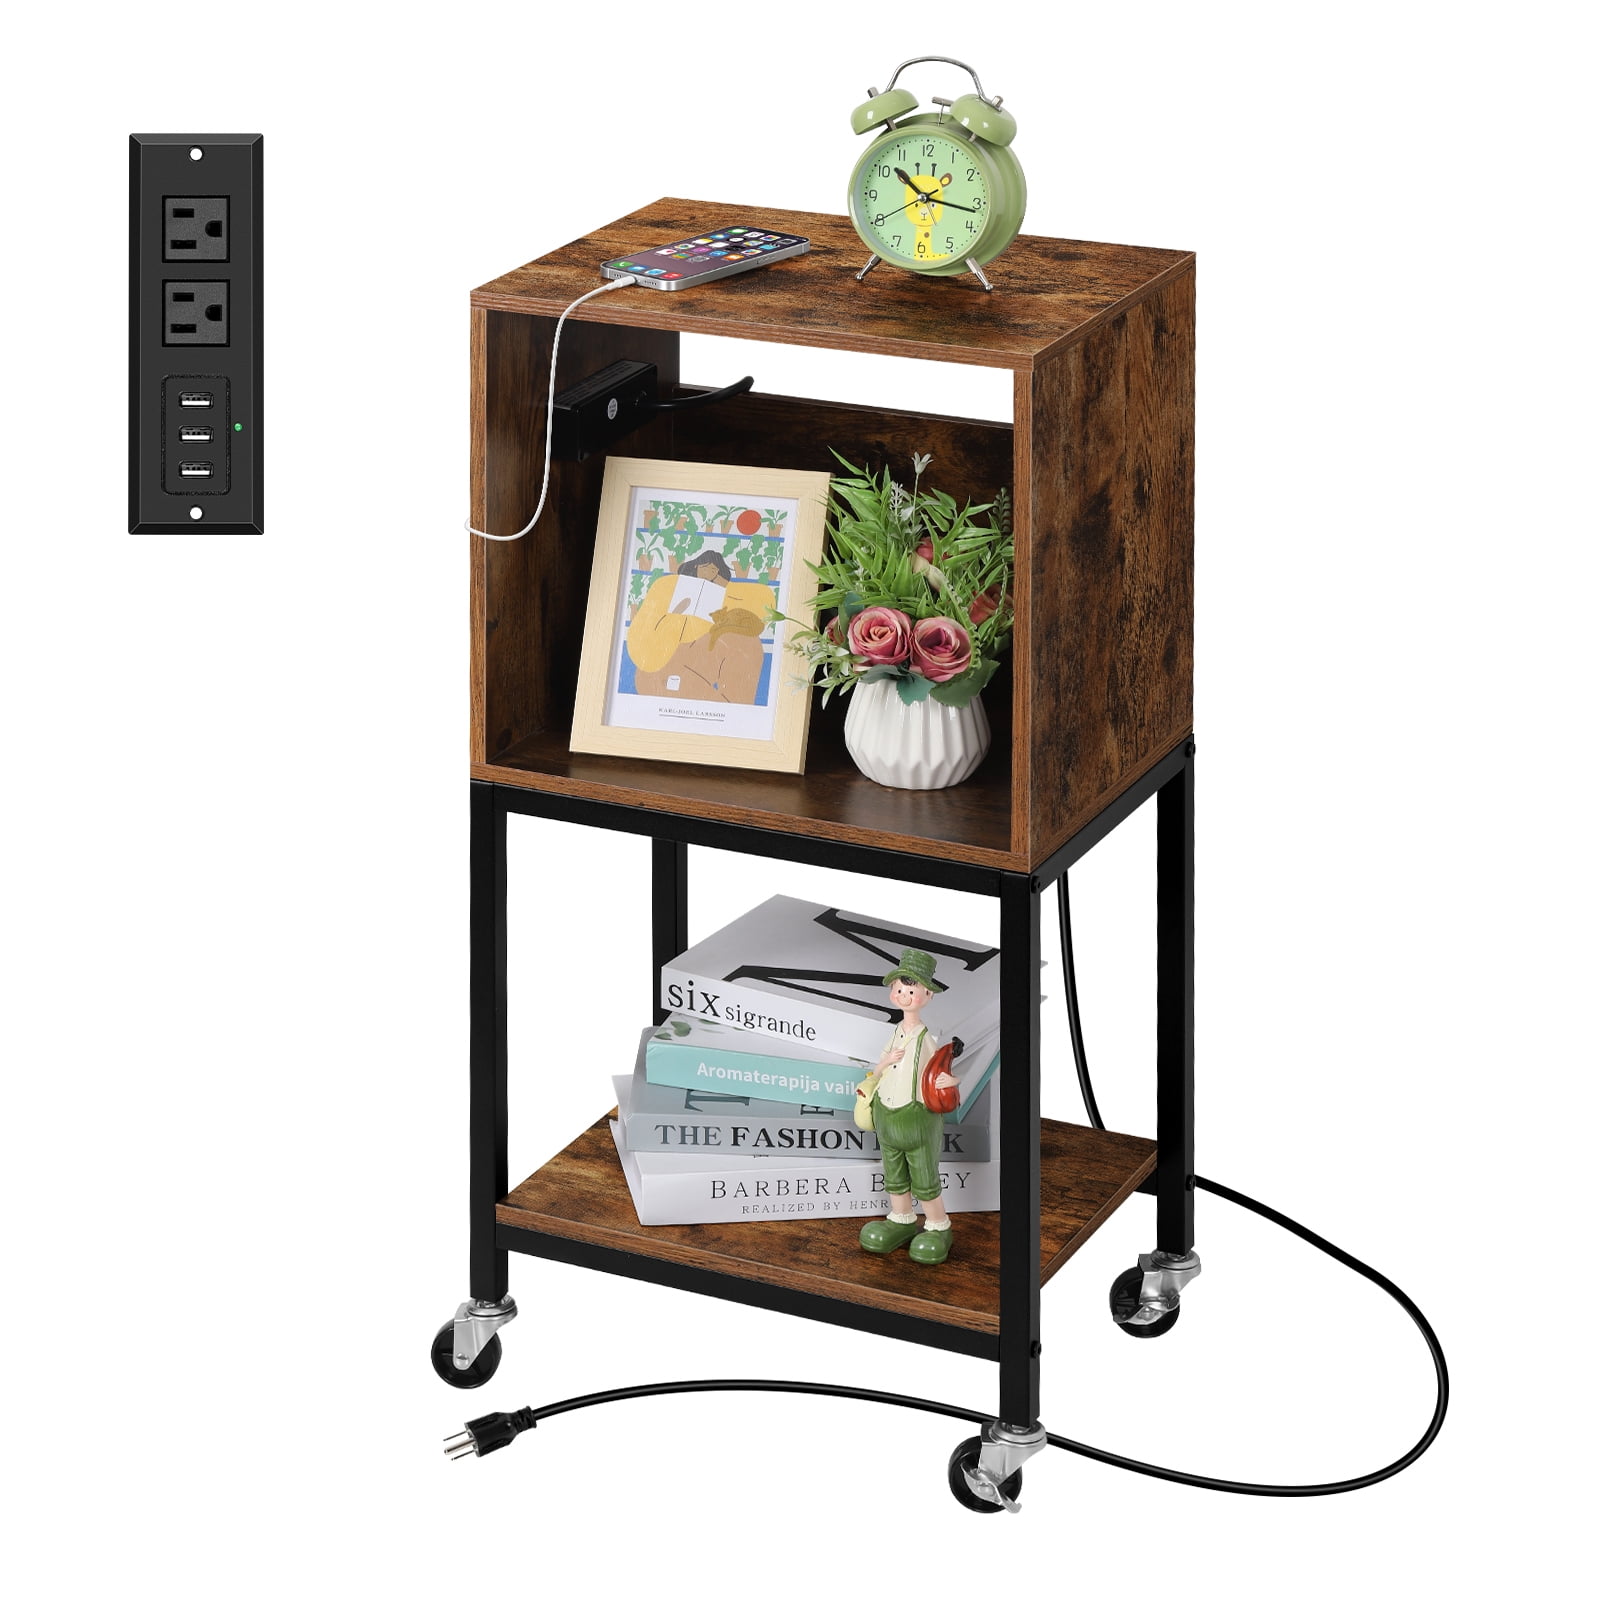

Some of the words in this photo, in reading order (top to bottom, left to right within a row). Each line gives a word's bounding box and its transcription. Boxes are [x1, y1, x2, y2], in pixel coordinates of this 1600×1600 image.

[898, 149, 906, 161] 11
[922, 144, 935, 157] 12
[951, 152, 955, 164] 1
[878, 165, 891, 178] 10
[966, 168, 975, 182] 2
[868, 189, 878, 202] 9
[972, 197, 982, 210] 3
[874, 213, 885, 227] 8
[965, 220, 974, 233] 4
[892, 235, 902, 247] 7
[917, 241, 926, 254] 6
[945, 237, 954, 249] 5
[667, 979, 721, 1018] six
[724, 1004, 817, 1041] sigrande
[696, 1062, 820, 1091] Aromaterapija
[654, 1124, 722, 1146] THE
[730, 1126, 865, 1151] FASHON
[711, 1176, 851, 1199] BARBERA
[742, 1203, 815, 1214] REALIZED
[823, 1201, 841, 1211] BY
